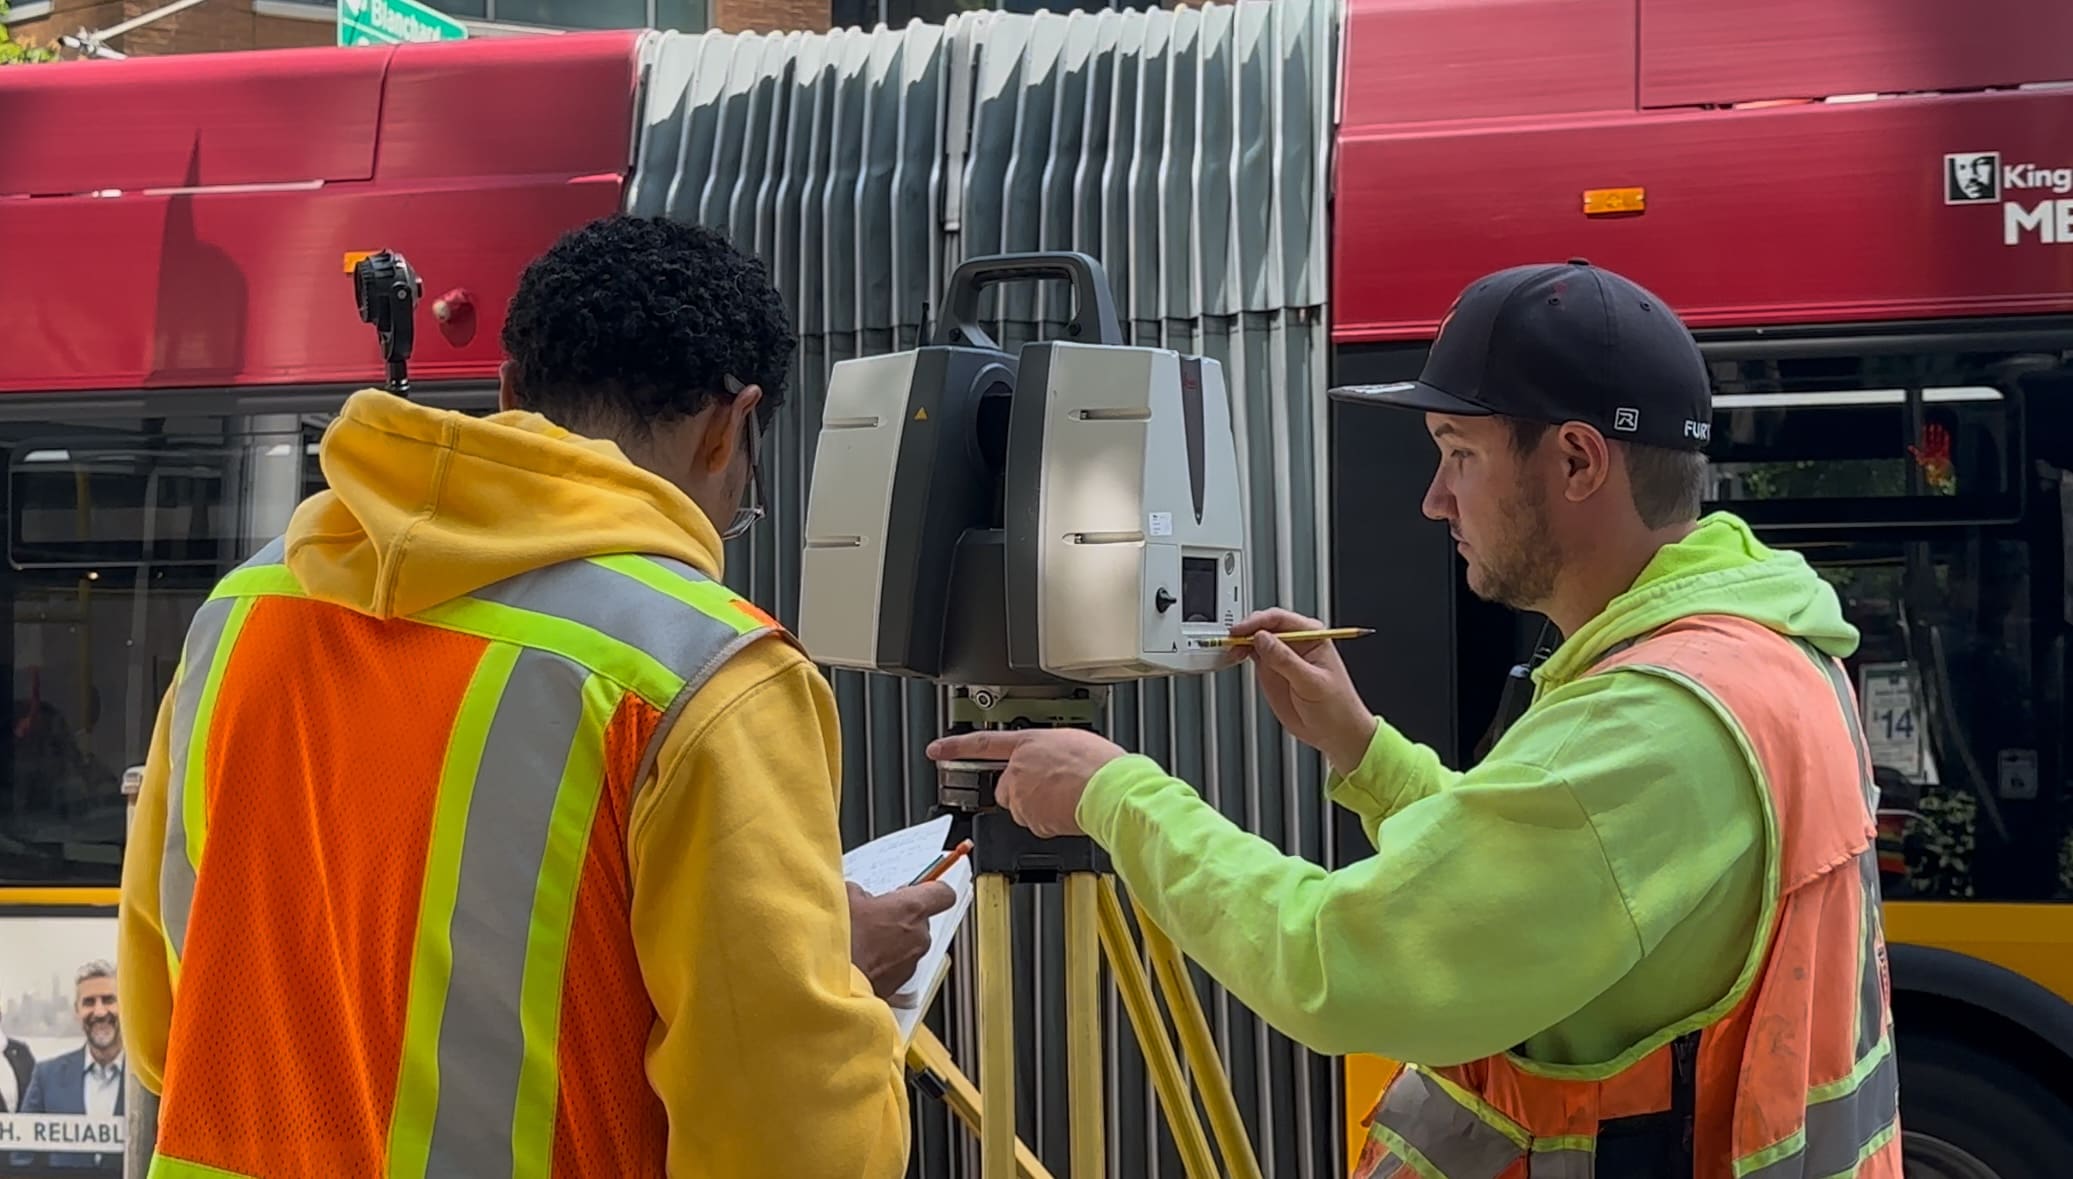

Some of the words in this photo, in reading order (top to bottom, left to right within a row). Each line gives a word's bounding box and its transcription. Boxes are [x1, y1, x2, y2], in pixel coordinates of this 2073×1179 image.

[371, 0, 441, 42] Blanchard
[2004, 164, 2072, 193] King
[0, 1122, 21, 1142] H.
[34, 1122, 124, 1143] RELIABL
